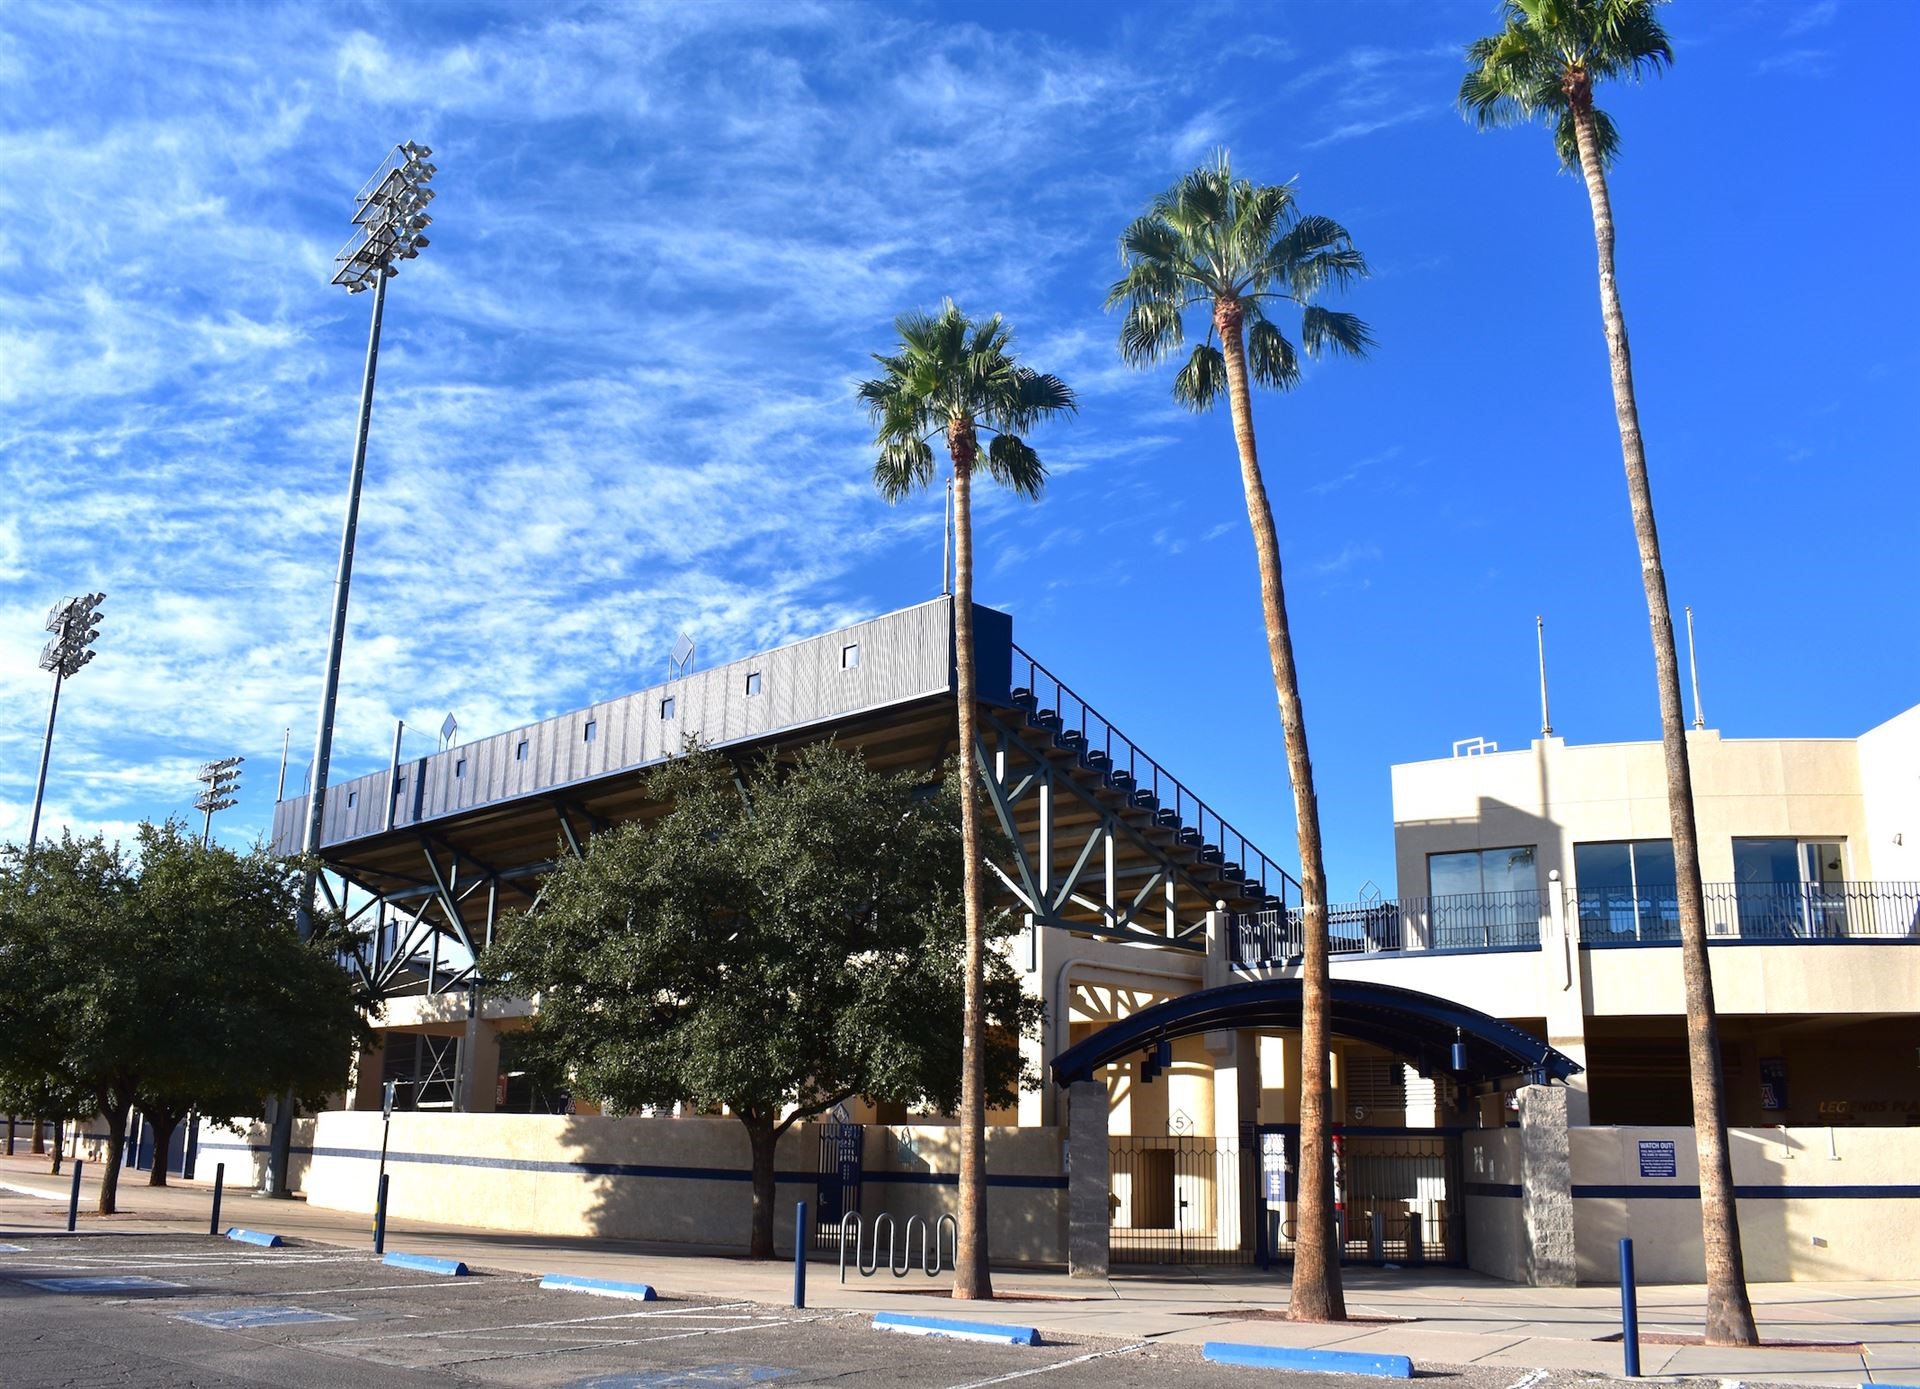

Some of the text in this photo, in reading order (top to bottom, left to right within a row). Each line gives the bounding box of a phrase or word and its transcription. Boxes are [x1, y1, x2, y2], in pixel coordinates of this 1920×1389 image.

[1355, 1107, 1364, 1119] 5
[1819, 1101, 1887, 1113] LEGENDS
[1175, 1117, 1184, 1129] 5
